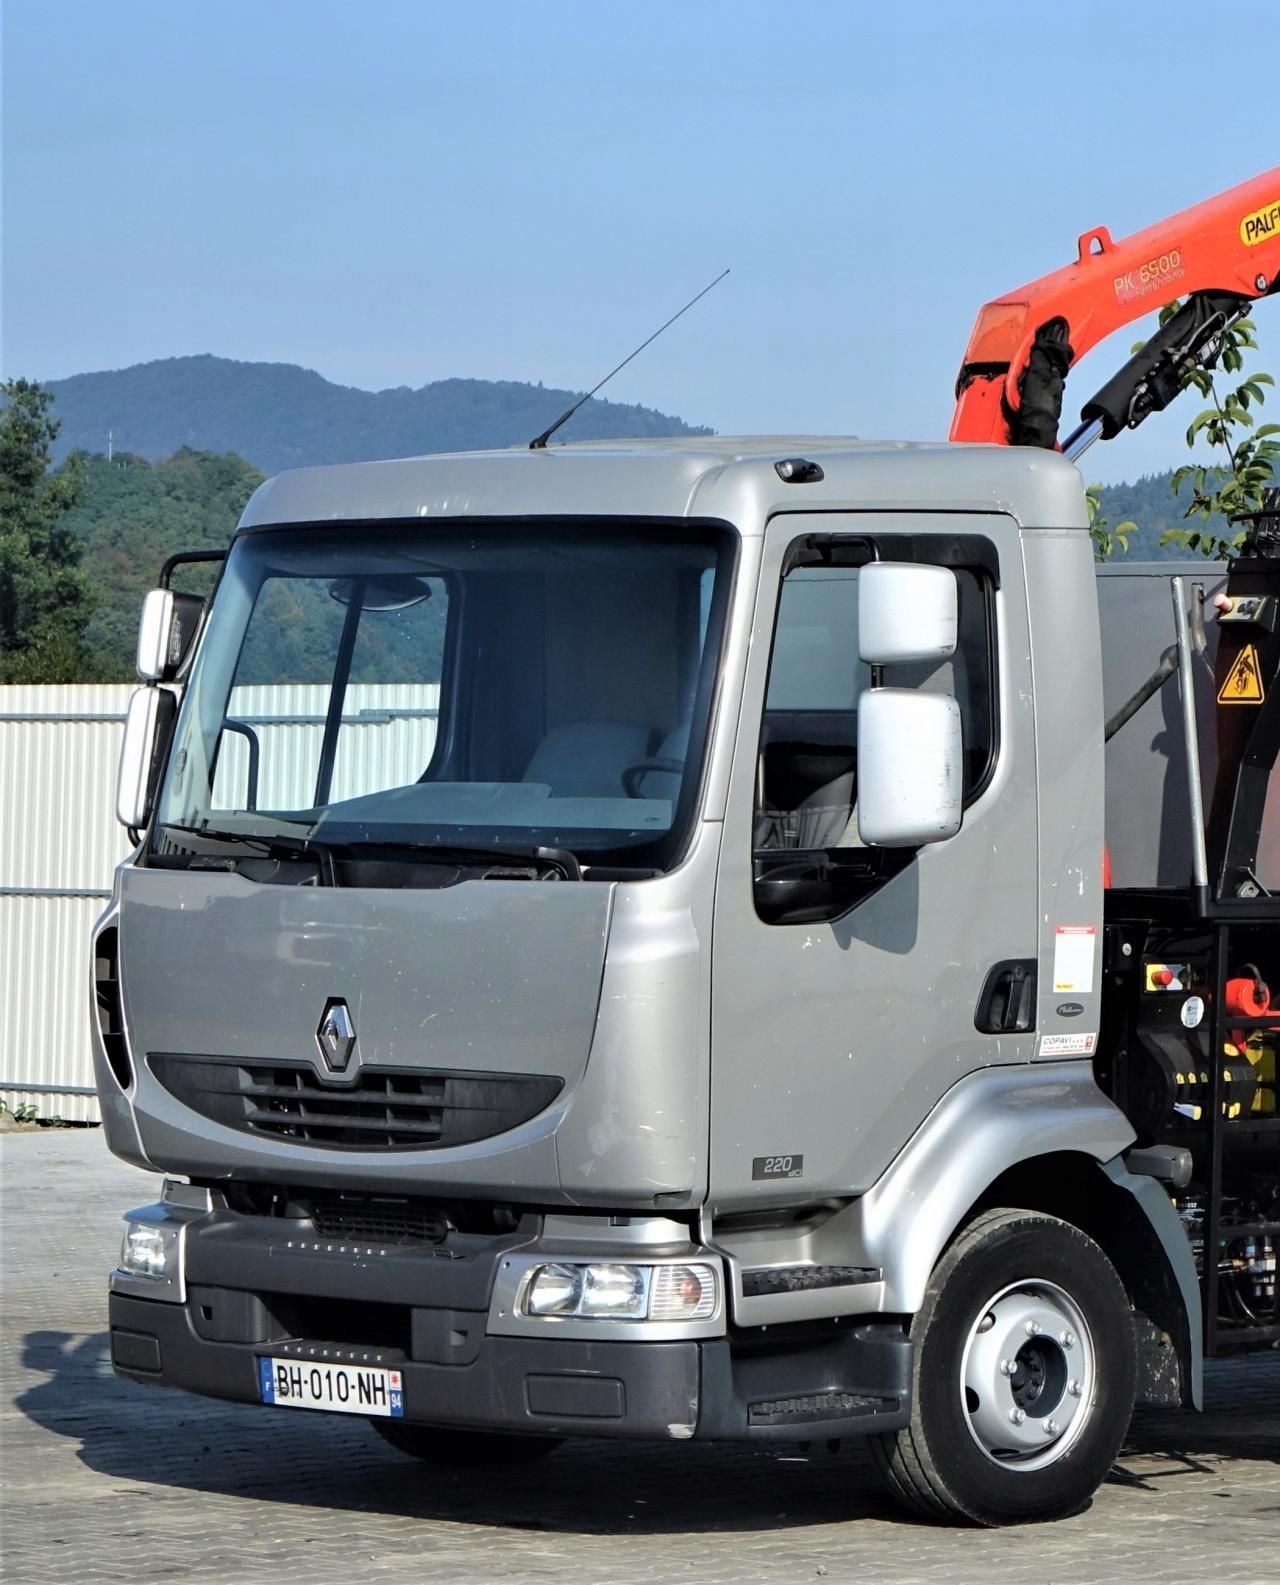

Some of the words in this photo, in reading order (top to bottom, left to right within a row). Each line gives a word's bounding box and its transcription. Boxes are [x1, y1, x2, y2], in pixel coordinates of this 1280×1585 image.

[1114, 272, 1134, 297] PK
[1140, 250, 1180, 282] 6500
[764, 1157, 792, 1173] 220
[265, 1381, 271, 1392] F
[277, 1364, 386, 1406] BH-010-NH
[391, 1392, 402, 1408] 94
